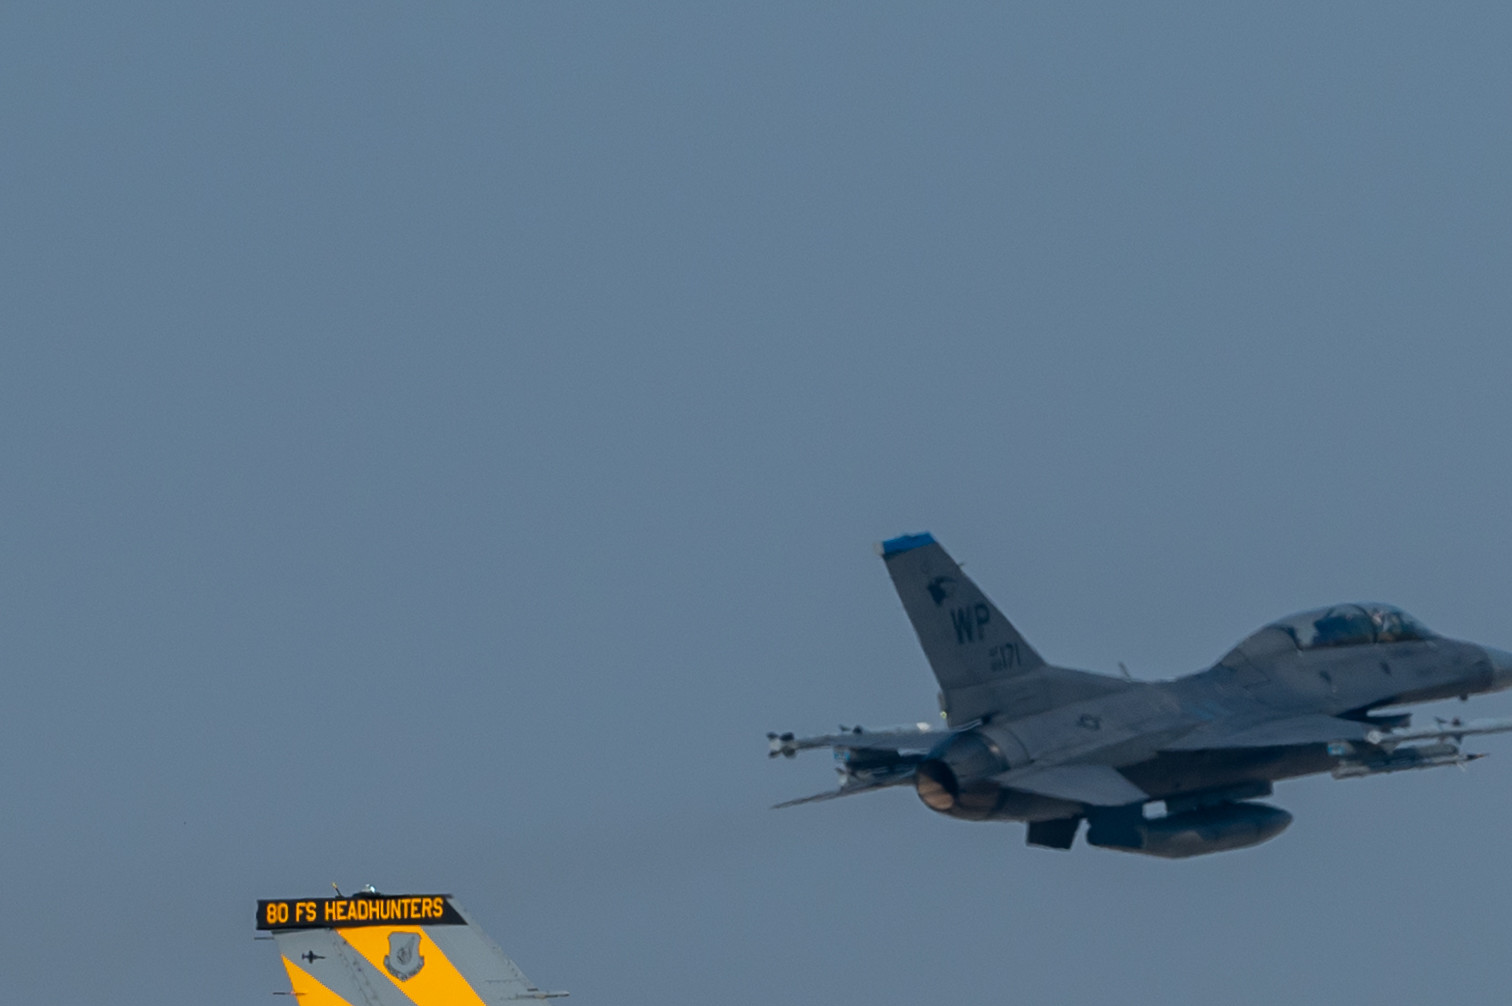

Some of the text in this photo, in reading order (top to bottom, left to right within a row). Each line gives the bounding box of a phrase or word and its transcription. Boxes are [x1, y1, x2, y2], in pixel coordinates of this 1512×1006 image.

[950, 603, 990, 645] WP
[266, 897, 444, 924] 80 FS HEADHUNTERS
